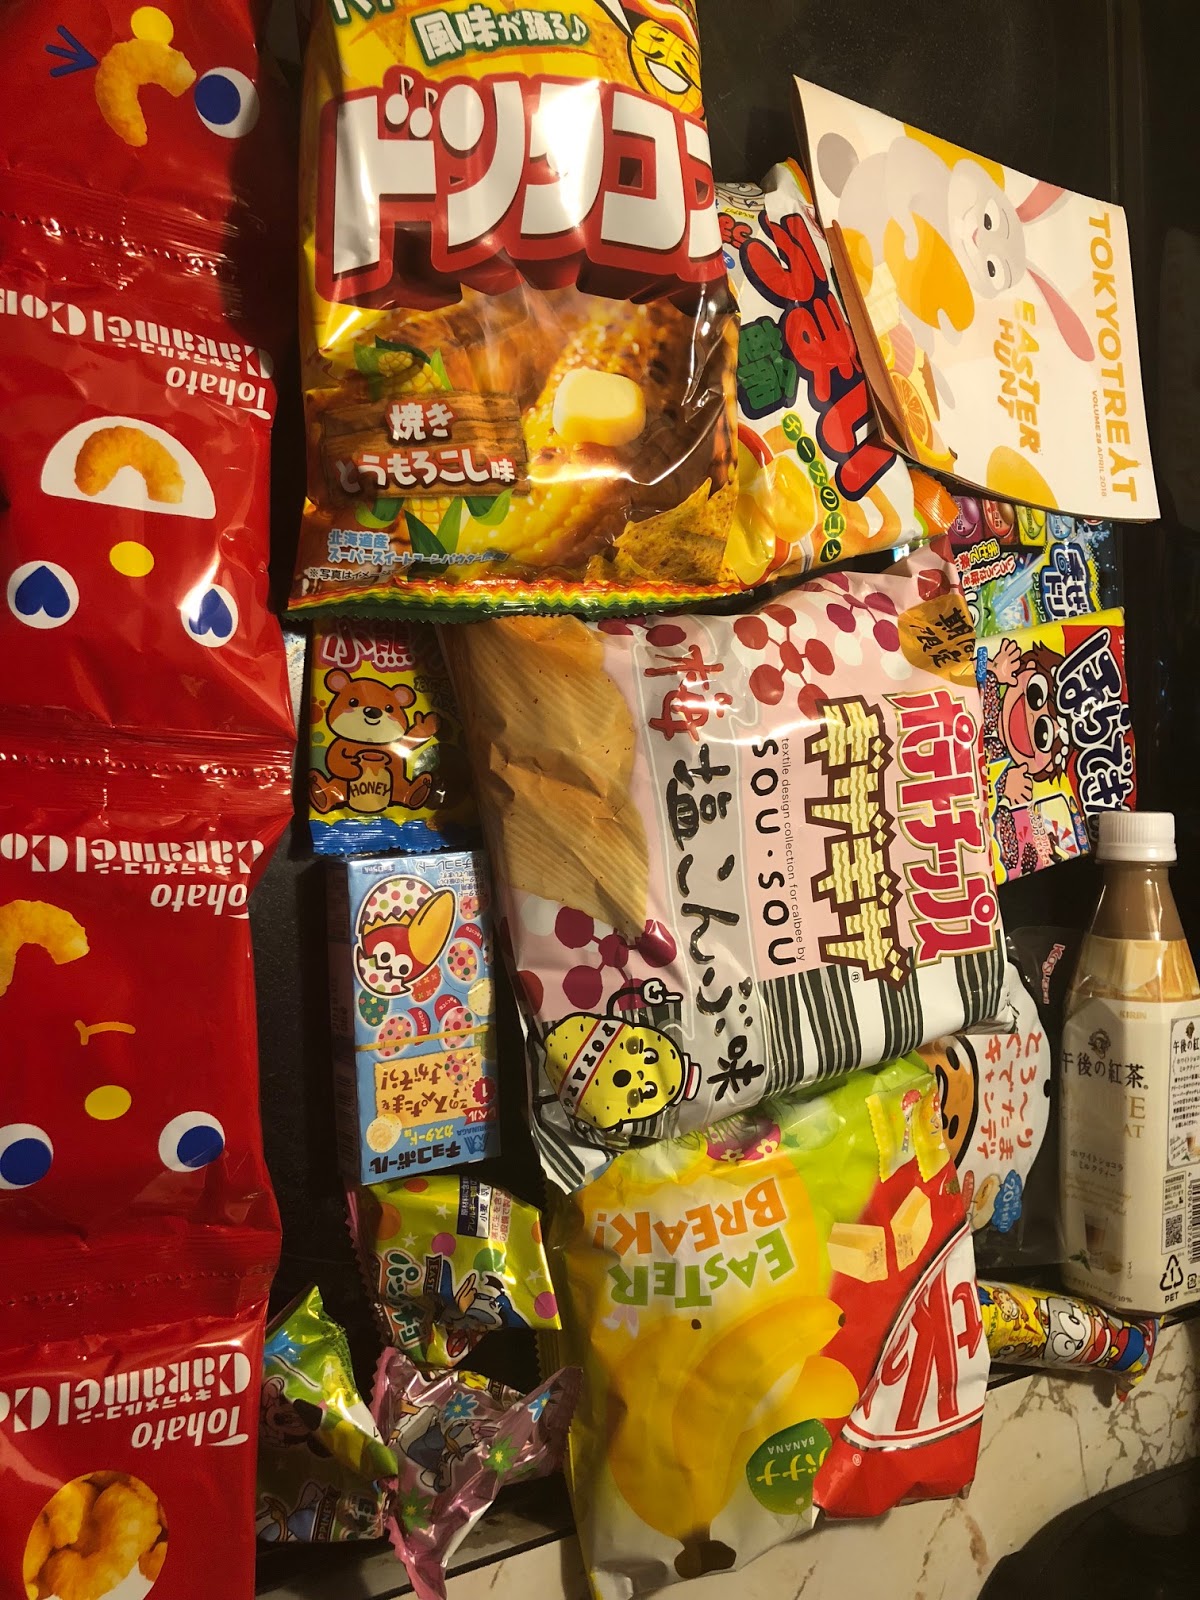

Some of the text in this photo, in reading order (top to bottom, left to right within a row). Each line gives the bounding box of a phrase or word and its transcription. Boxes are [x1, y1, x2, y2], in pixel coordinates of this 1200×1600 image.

[112, 337, 241, 373] キャラメルコーン
[993, 317, 1018, 418] HUNT
[1088, 212, 1141, 502] TOKYOTREAT
[165, 365, 272, 420] Tohato
[1014, 299, 1042, 454] EASTER
[390, 402, 454, 441] 焼き
[1092, 390, 1101, 431] VOLUME
[336, 448, 516, 493] とうもろこし味
[1097, 446, 1105, 474] APRIL
[781, 412, 846, 563] チーズのコク
[1099, 475, 1107, 497] 2018
[328, 529, 391, 550] 北海道産
[963, 556, 1016, 587] いろいろな味を
[1045, 572, 1066, 622] ドリ
[910, 624, 962, 669] 限定
[350, 781, 391, 798] HONEY
[806, 697, 909, 987] ギザギザ
[893, 690, 999, 963] ポテトチップス
[94, 862, 232, 876] キャラメルコーン
[781, 737, 806, 962] textile design collection for calbee by
[1119, 1010, 1147, 1020] KIRIN
[381, 1062, 443, 1092] さがそう!
[563, 1023, 616, 1108] POTATO
[1061, 1048, 1146, 1090] 午後の紅茶
[481, 1083, 489, 1098] 1
[977, 1034, 1002, 1159] キャンディ
[998, 1033, 1022, 1162] ぐでたま
[456, 1125, 490, 1136] ORINAGA
[370, 1141, 462, 1175] チョコボール
[591, 1177, 787, 1257] BREAK!
[428, 1263, 440, 1295] EASTE
[607, 1229, 796, 1309] EASTER
[1164, 1291, 1179, 1304] PET
[76, 1388, 212, 1425] キャラメルコーン
[131, 1405, 249, 1451] Tohato
[765, 1435, 816, 1456] BANANA
[754, 1446, 830, 1487] バナナ
